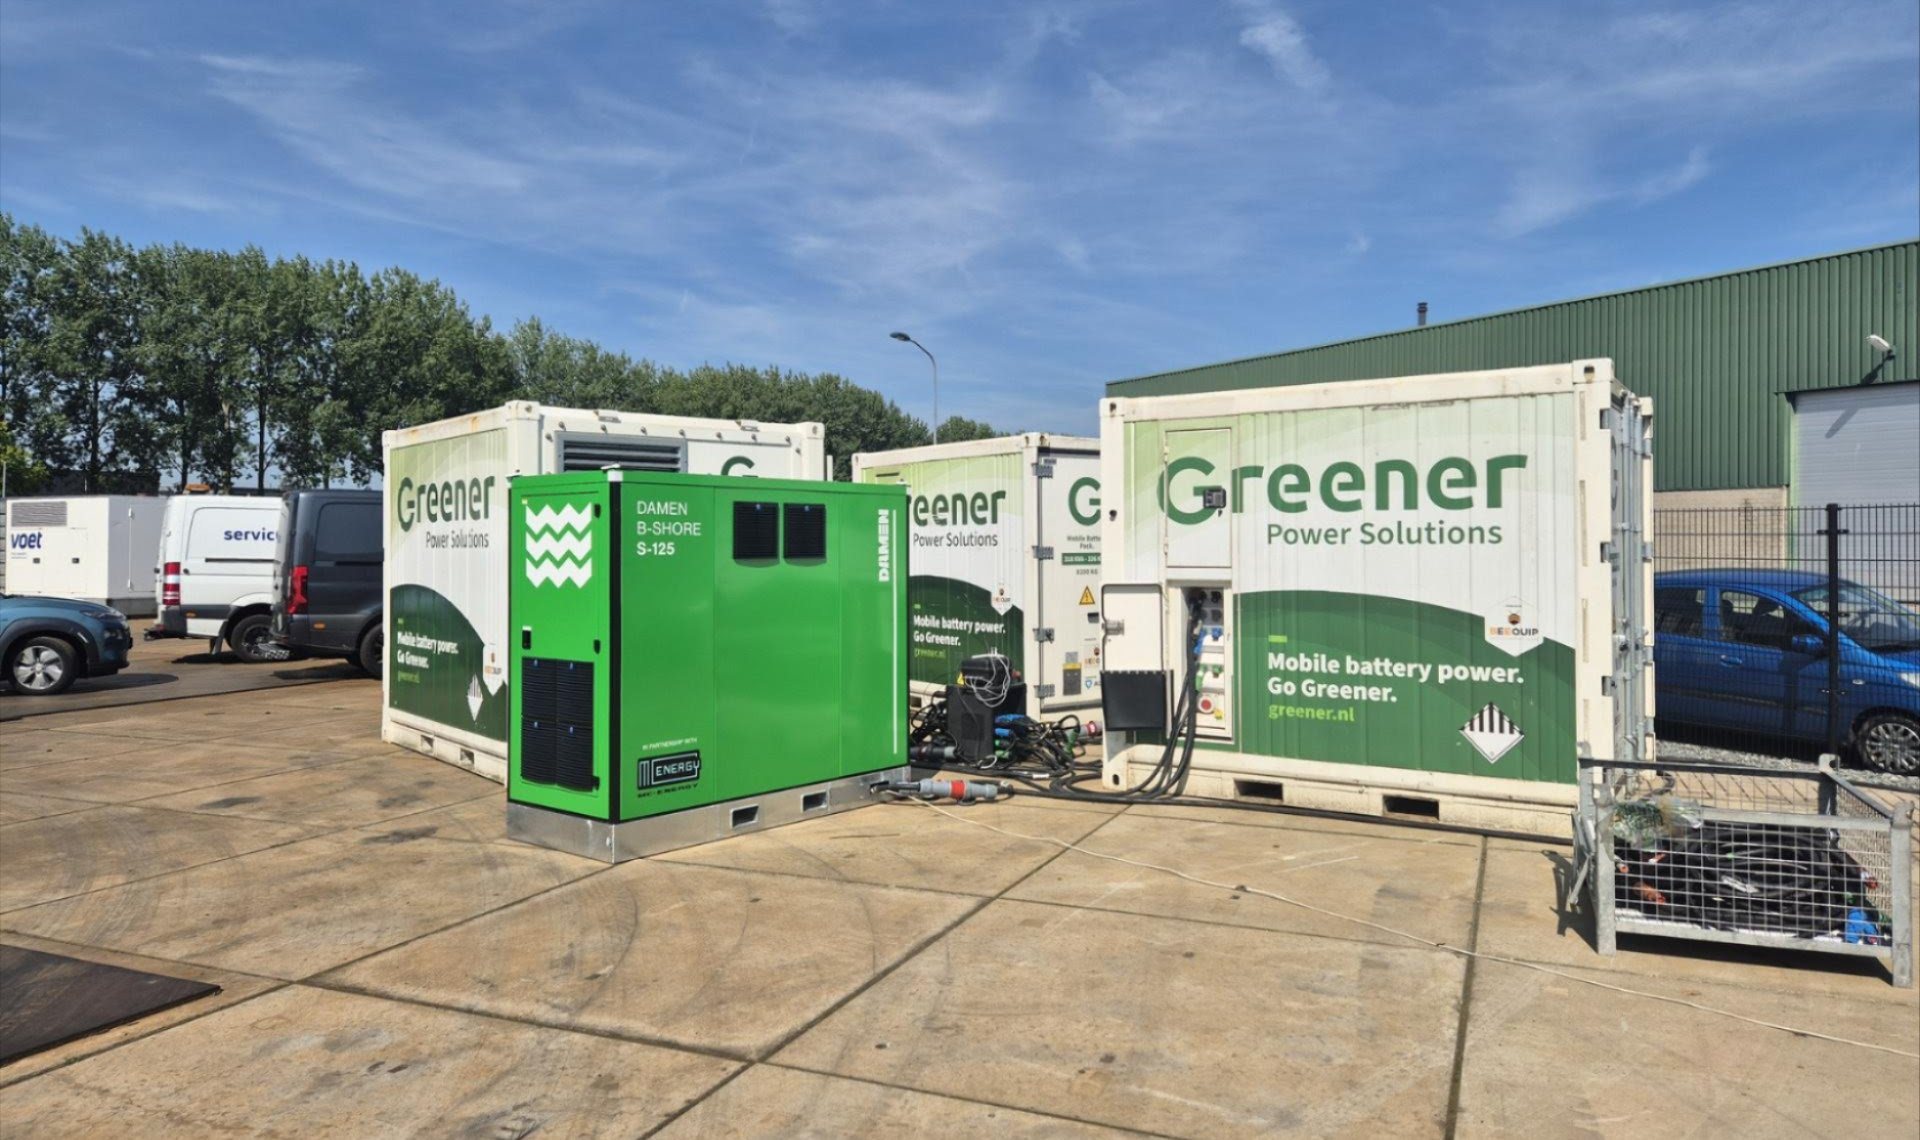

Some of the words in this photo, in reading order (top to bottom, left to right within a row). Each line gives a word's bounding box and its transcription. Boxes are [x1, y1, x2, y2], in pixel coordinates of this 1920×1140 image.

[1157, 454, 1528, 526] Greener
[397, 475, 495, 532] Greener
[637, 500, 688, 515] DAMEN
[909, 489, 1007, 527] eener
[425, 531, 449, 549] Power
[451, 528, 490, 548] Solutions
[637, 520, 703, 536] B-SHORE
[1267, 523, 1352, 545] Power
[1360, 519, 1503, 545] Solutions
[11, 531, 43, 549] voet
[636, 541, 676, 556] S-125
[878, 508, 890, 582] DAMEN
[913, 533, 944, 547] Power
[946, 530, 998, 548] Solutions
[913, 614, 940, 629] Mobile
[941, 616, 974, 634] battery
[974, 621, 1006, 635] power.
[913, 631, 925, 642] Go
[925, 631, 961, 647] Greener.
[1268, 652, 1340, 674] Mobile
[1345, 654, 1432, 683] battery
[1438, 663, 1525, 685] power.
[1267, 676, 1297, 696] Go
[1301, 678, 1398, 703] Greener.
[1268, 704, 1356, 722] greener.nl
[655, 759, 700, 777] ENERGY
